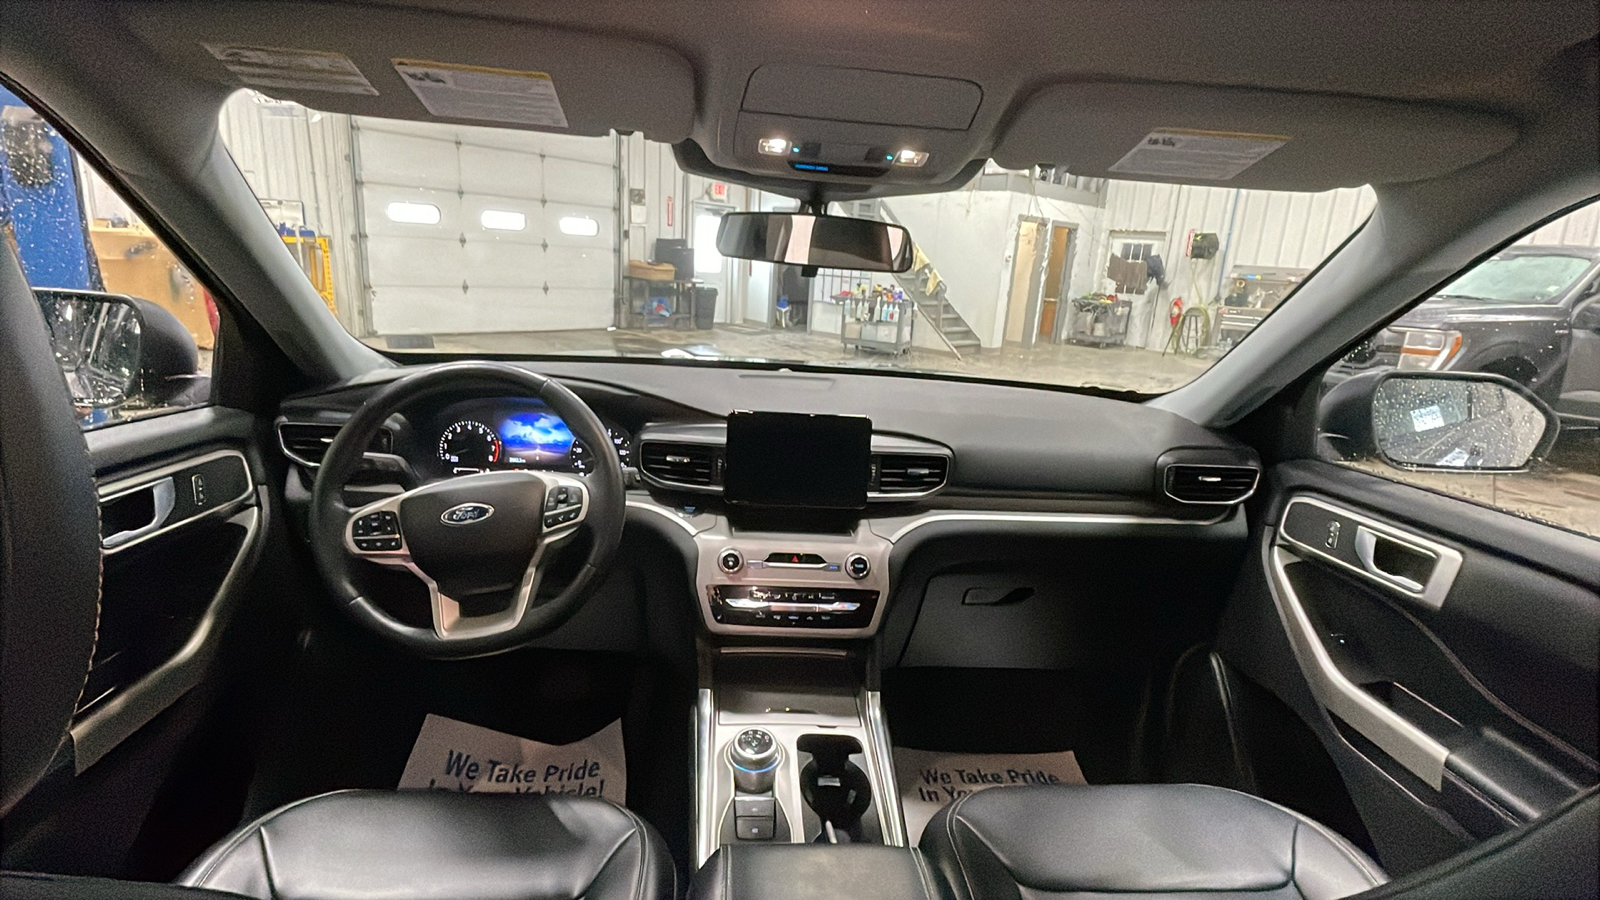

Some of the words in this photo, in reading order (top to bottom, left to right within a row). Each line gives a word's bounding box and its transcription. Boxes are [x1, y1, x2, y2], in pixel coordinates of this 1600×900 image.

[445, 452, 450, 460] 0
[446, 750, 480, 780] We
[487, 760, 536, 783] Take
[543, 759, 601, 783] Pride
[921, 768, 951, 785] We
[954, 768, 1003, 784] Take
[1006, 768, 1060, 786] Pride
[918, 786, 940, 802] In
